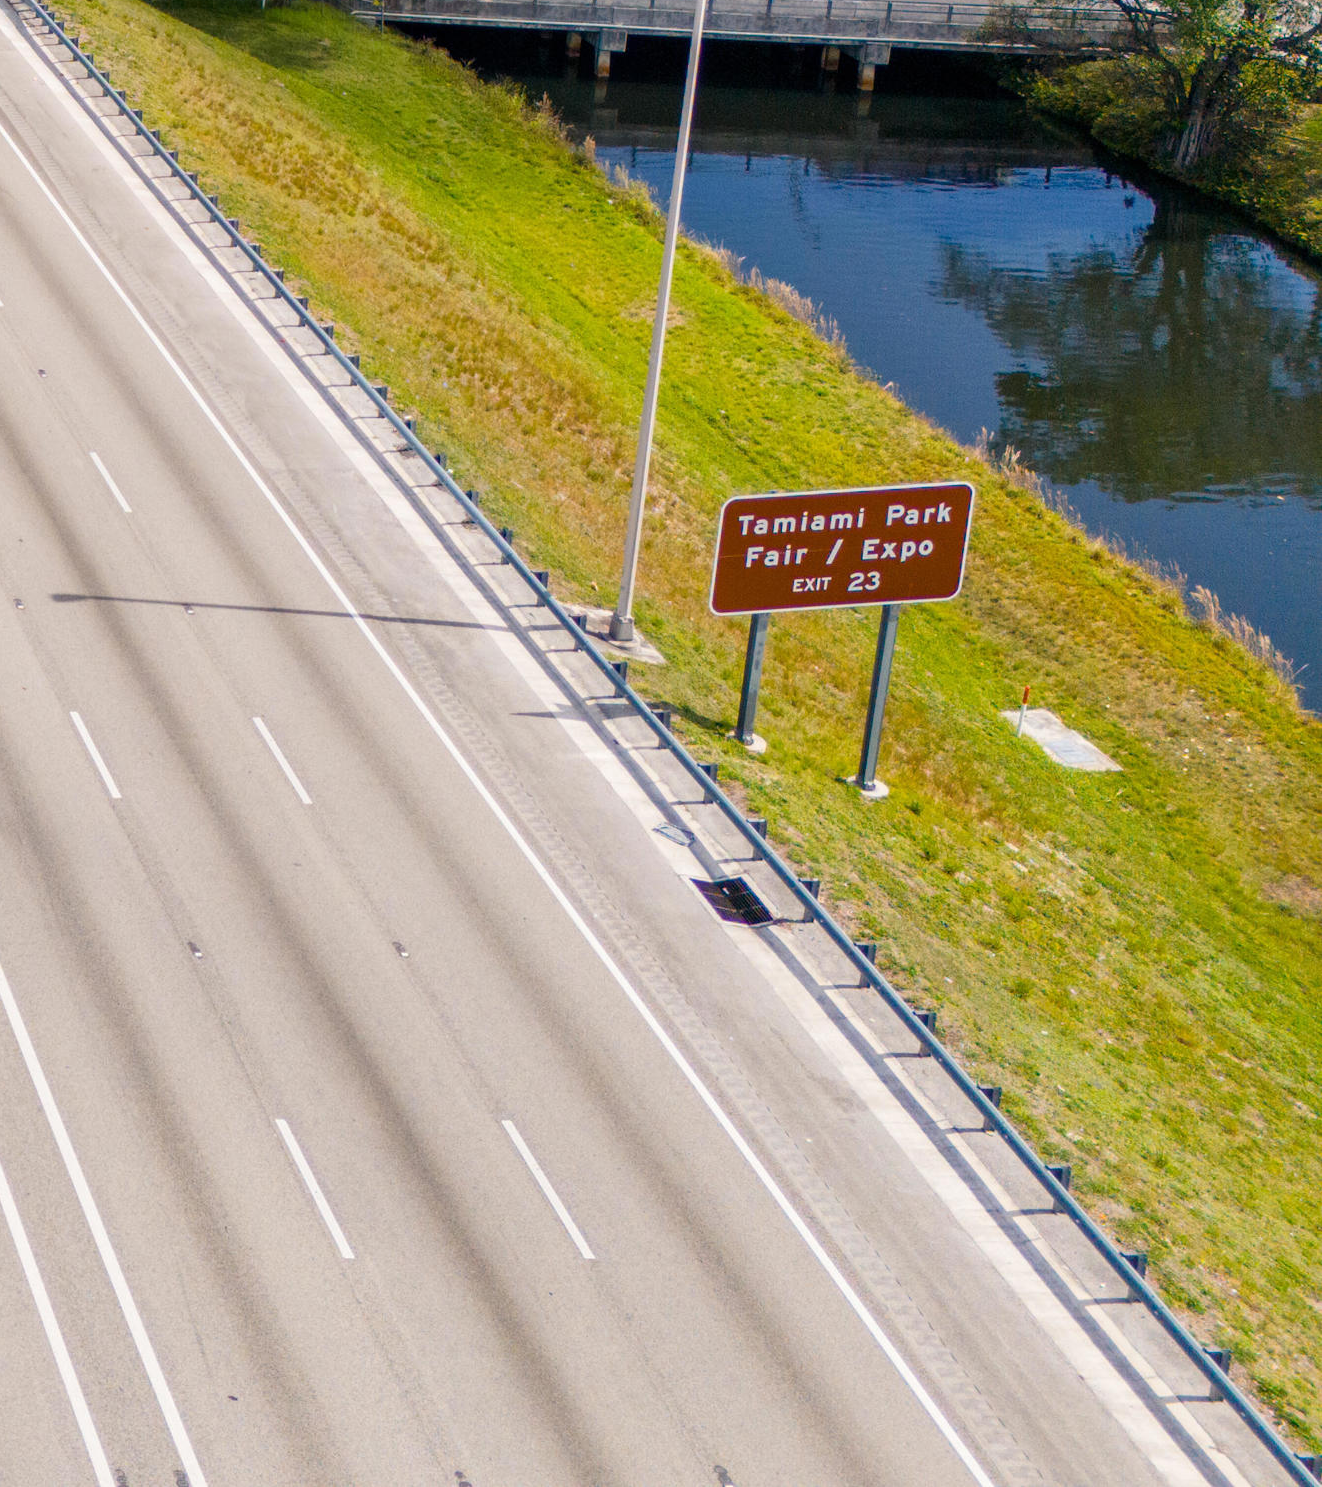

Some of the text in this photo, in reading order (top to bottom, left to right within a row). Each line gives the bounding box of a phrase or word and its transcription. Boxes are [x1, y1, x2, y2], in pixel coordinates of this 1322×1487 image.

[738, 502, 952, 536] Tamiami Park
[745, 538, 934, 568] Fair / Expo
[792, 571, 881, 593] EXIT 23
